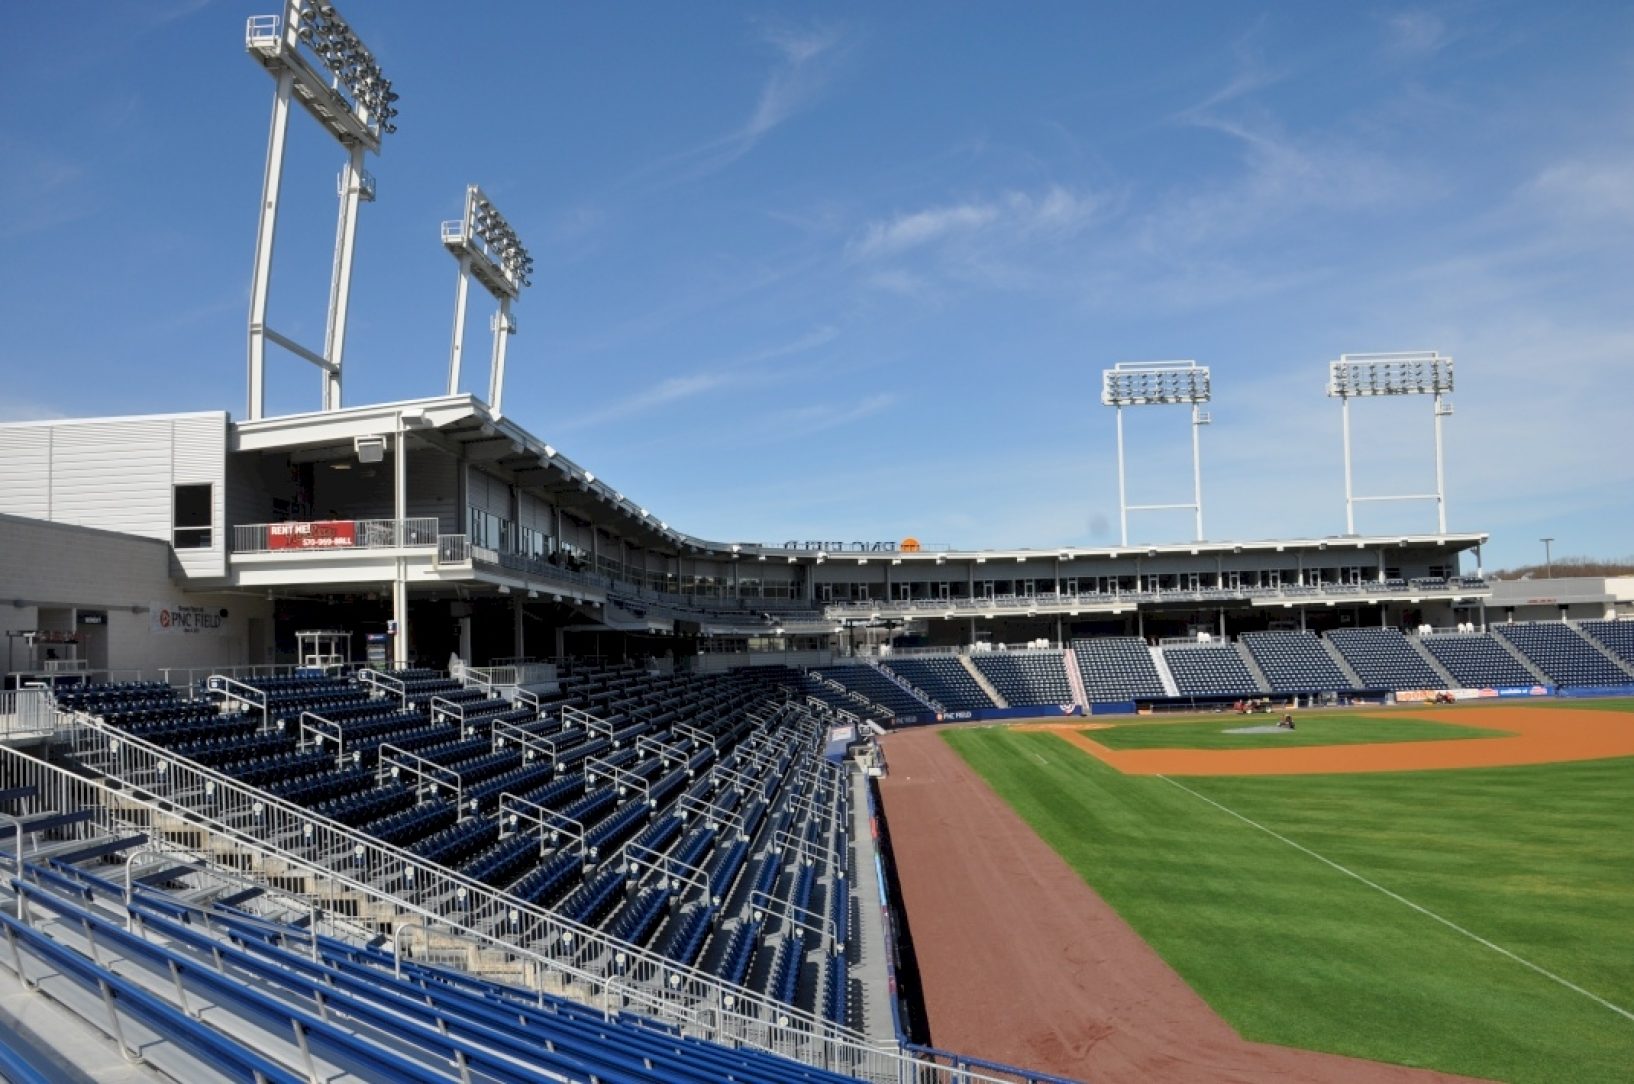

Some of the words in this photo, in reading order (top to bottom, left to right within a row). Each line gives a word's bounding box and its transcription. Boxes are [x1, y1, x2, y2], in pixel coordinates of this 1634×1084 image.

[271, 525, 293, 535] RENT
[171, 611, 192, 627] PNC
[195, 613, 221, 628] FIELD
[943, 712, 955, 720] PNC
[956, 711, 972, 719] FIELD
